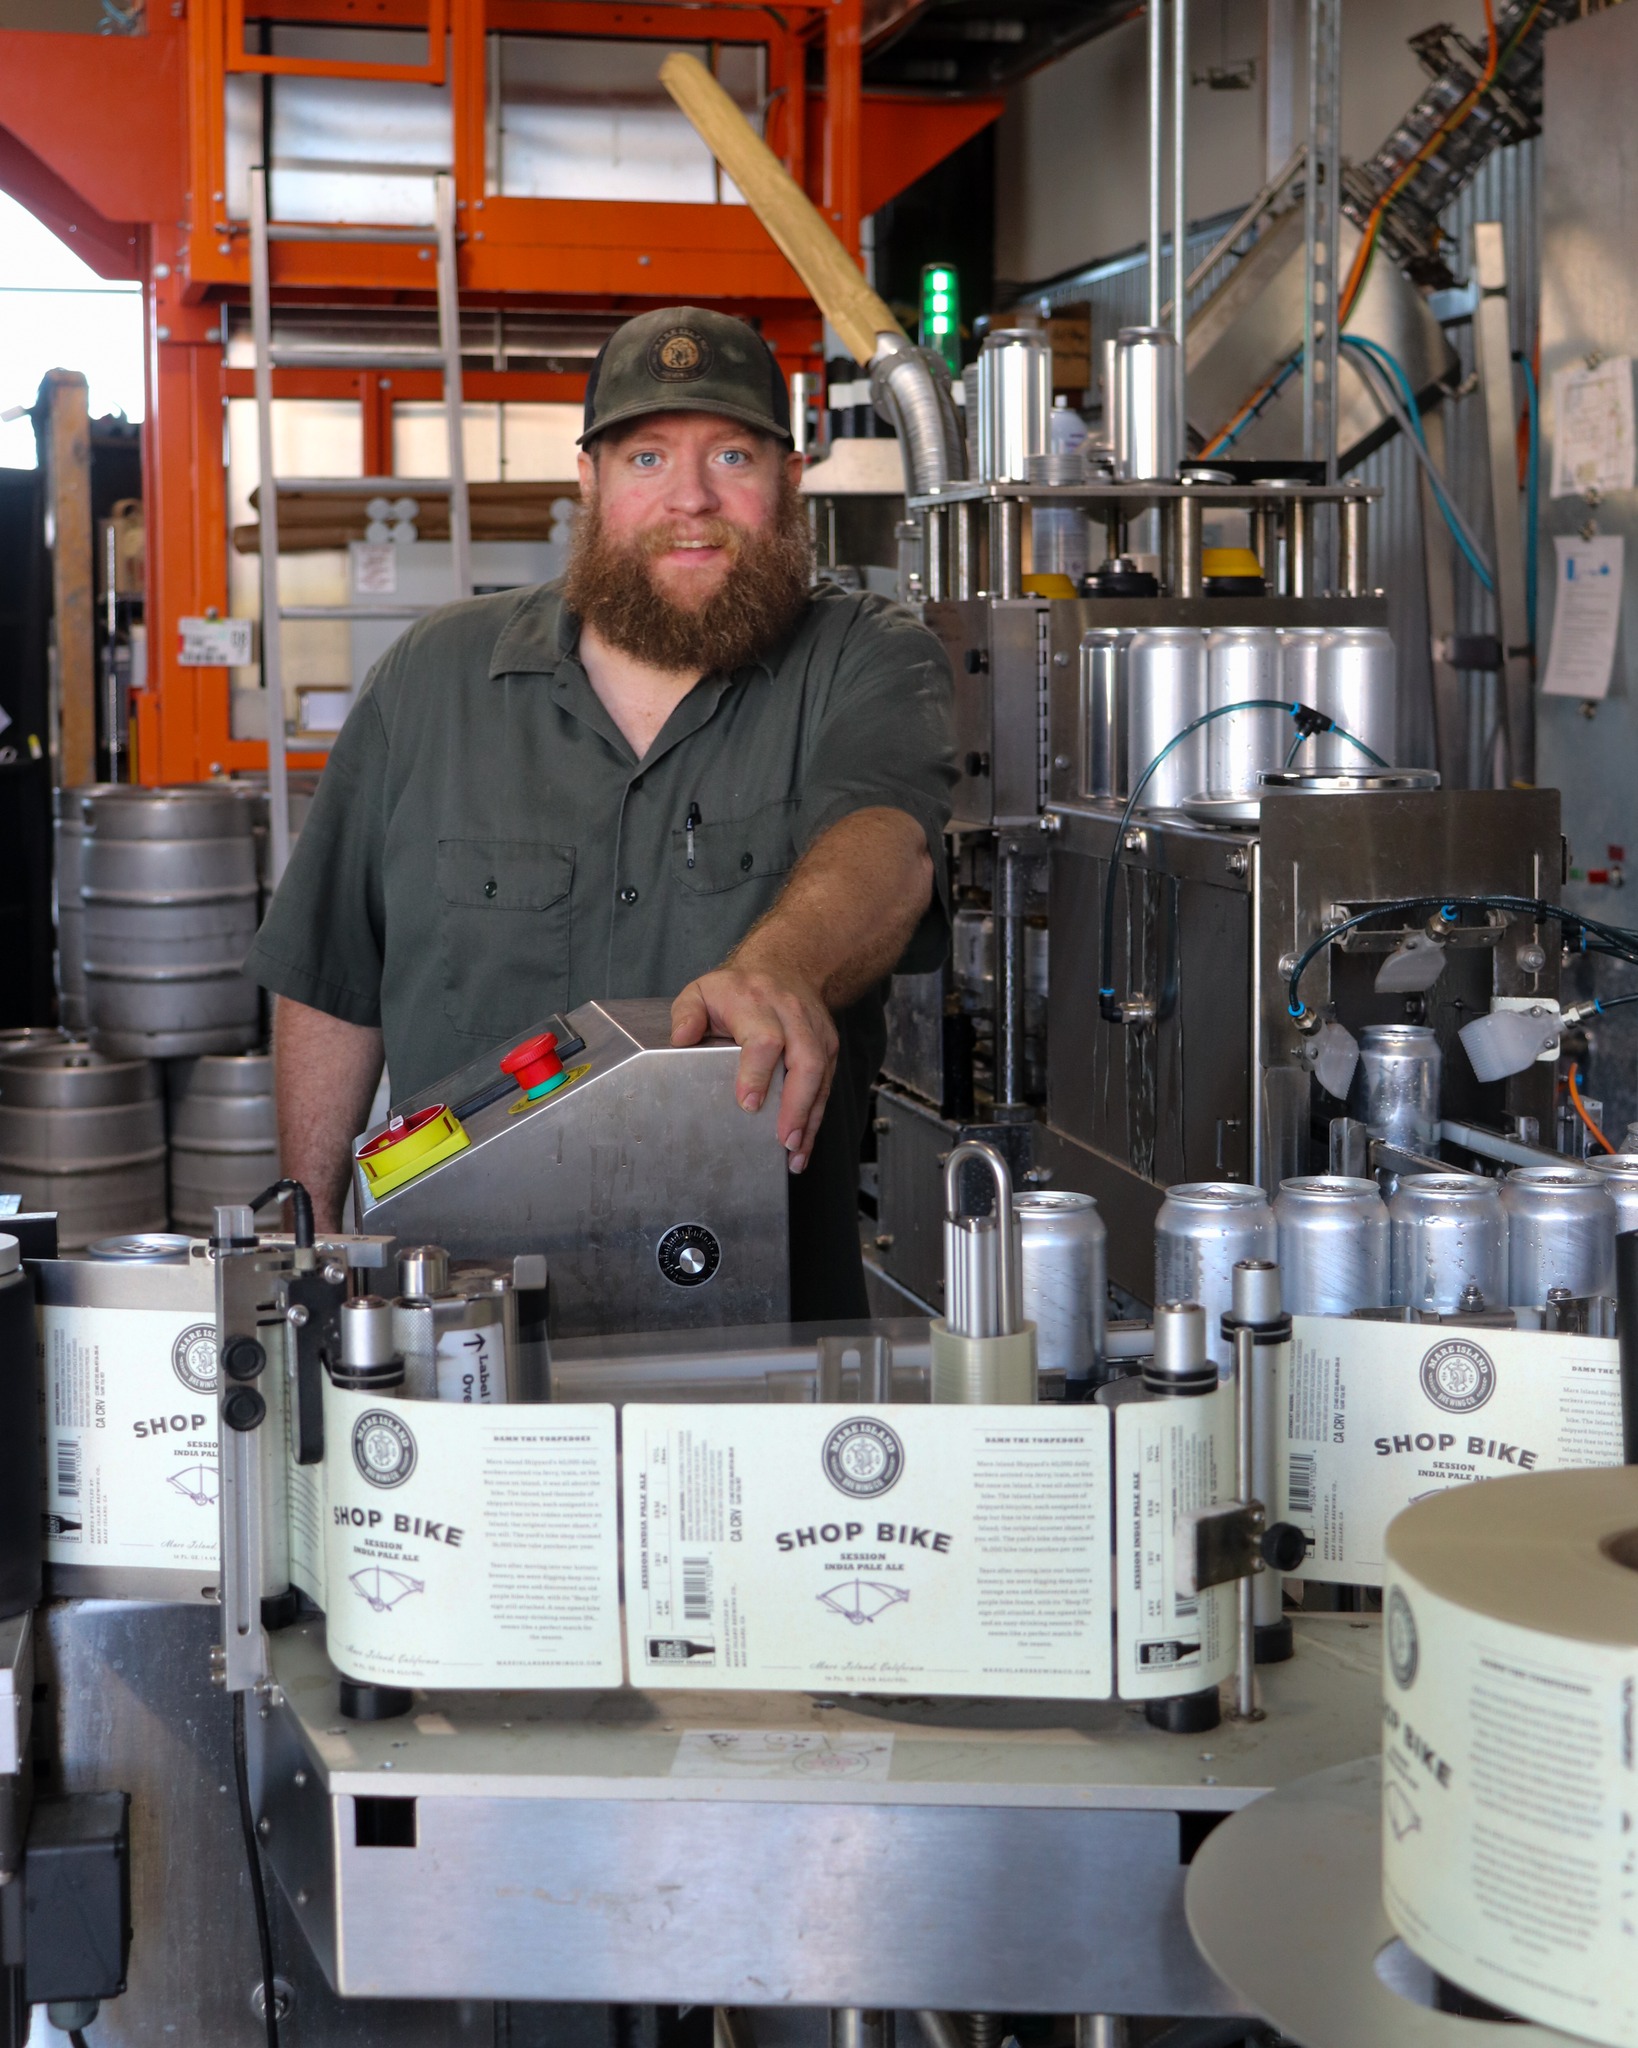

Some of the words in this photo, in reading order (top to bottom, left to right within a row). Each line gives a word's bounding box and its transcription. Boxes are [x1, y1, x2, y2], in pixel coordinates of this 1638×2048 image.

[179, 1330, 201, 1354] MARE
[1428, 1345, 1455, 1370] MARE
[1456, 1345, 1488, 1374] ISLAND
[479, 1354, 490, 1398] Label
[1597, 1367, 1614, 1375] THE
[189, 1376, 214, 1389] BREWING
[95, 1399, 106, 1415] CRV
[1437, 1392, 1467, 1407] BREWING
[96, 1417, 106, 1428] CA
[133, 1414, 207, 1438] SHOP
[1333, 1413, 1345, 1430] CRV
[357, 1416, 378, 1441] MARE
[378, 1415, 409, 1448] ISLAND
[830, 1424, 859, 1453] MARE
[860, 1424, 895, 1454] ISLAND
[1333, 1431, 1345, 1443] CA
[187, 1441, 218, 1449] SESSIO
[1374, 1432, 1456, 1457] SHOP
[1467, 1435, 1539, 1470] BIKE
[1432, 1461, 1476, 1471] SESSION
[639, 1472, 647, 1491] ALE
[1418, 1470, 1446, 1479] INDIA
[1448, 1471, 1472, 1481] PALE
[640, 1493, 648, 1518] PALE
[334, 1506, 382, 1528] SHOP
[393, 1513, 465, 1547] BIKE
[730, 1508, 743, 1528] CRV
[640, 1521, 648, 1549] INDIA
[730, 1530, 743, 1542] CA
[776, 1522, 864, 1551] SHOP
[877, 1522, 953, 1554] BIKE
[160, 1540, 185, 1549] Mare
[364, 1538, 402, 1550] SESSION
[354, 1546, 376, 1557] INDIA
[377, 1550, 399, 1561] PALE
[402, 1553, 420, 1562] ALE
[840, 1553, 886, 1561] SESSION
[1403, 1720, 1453, 1790] BIKE
